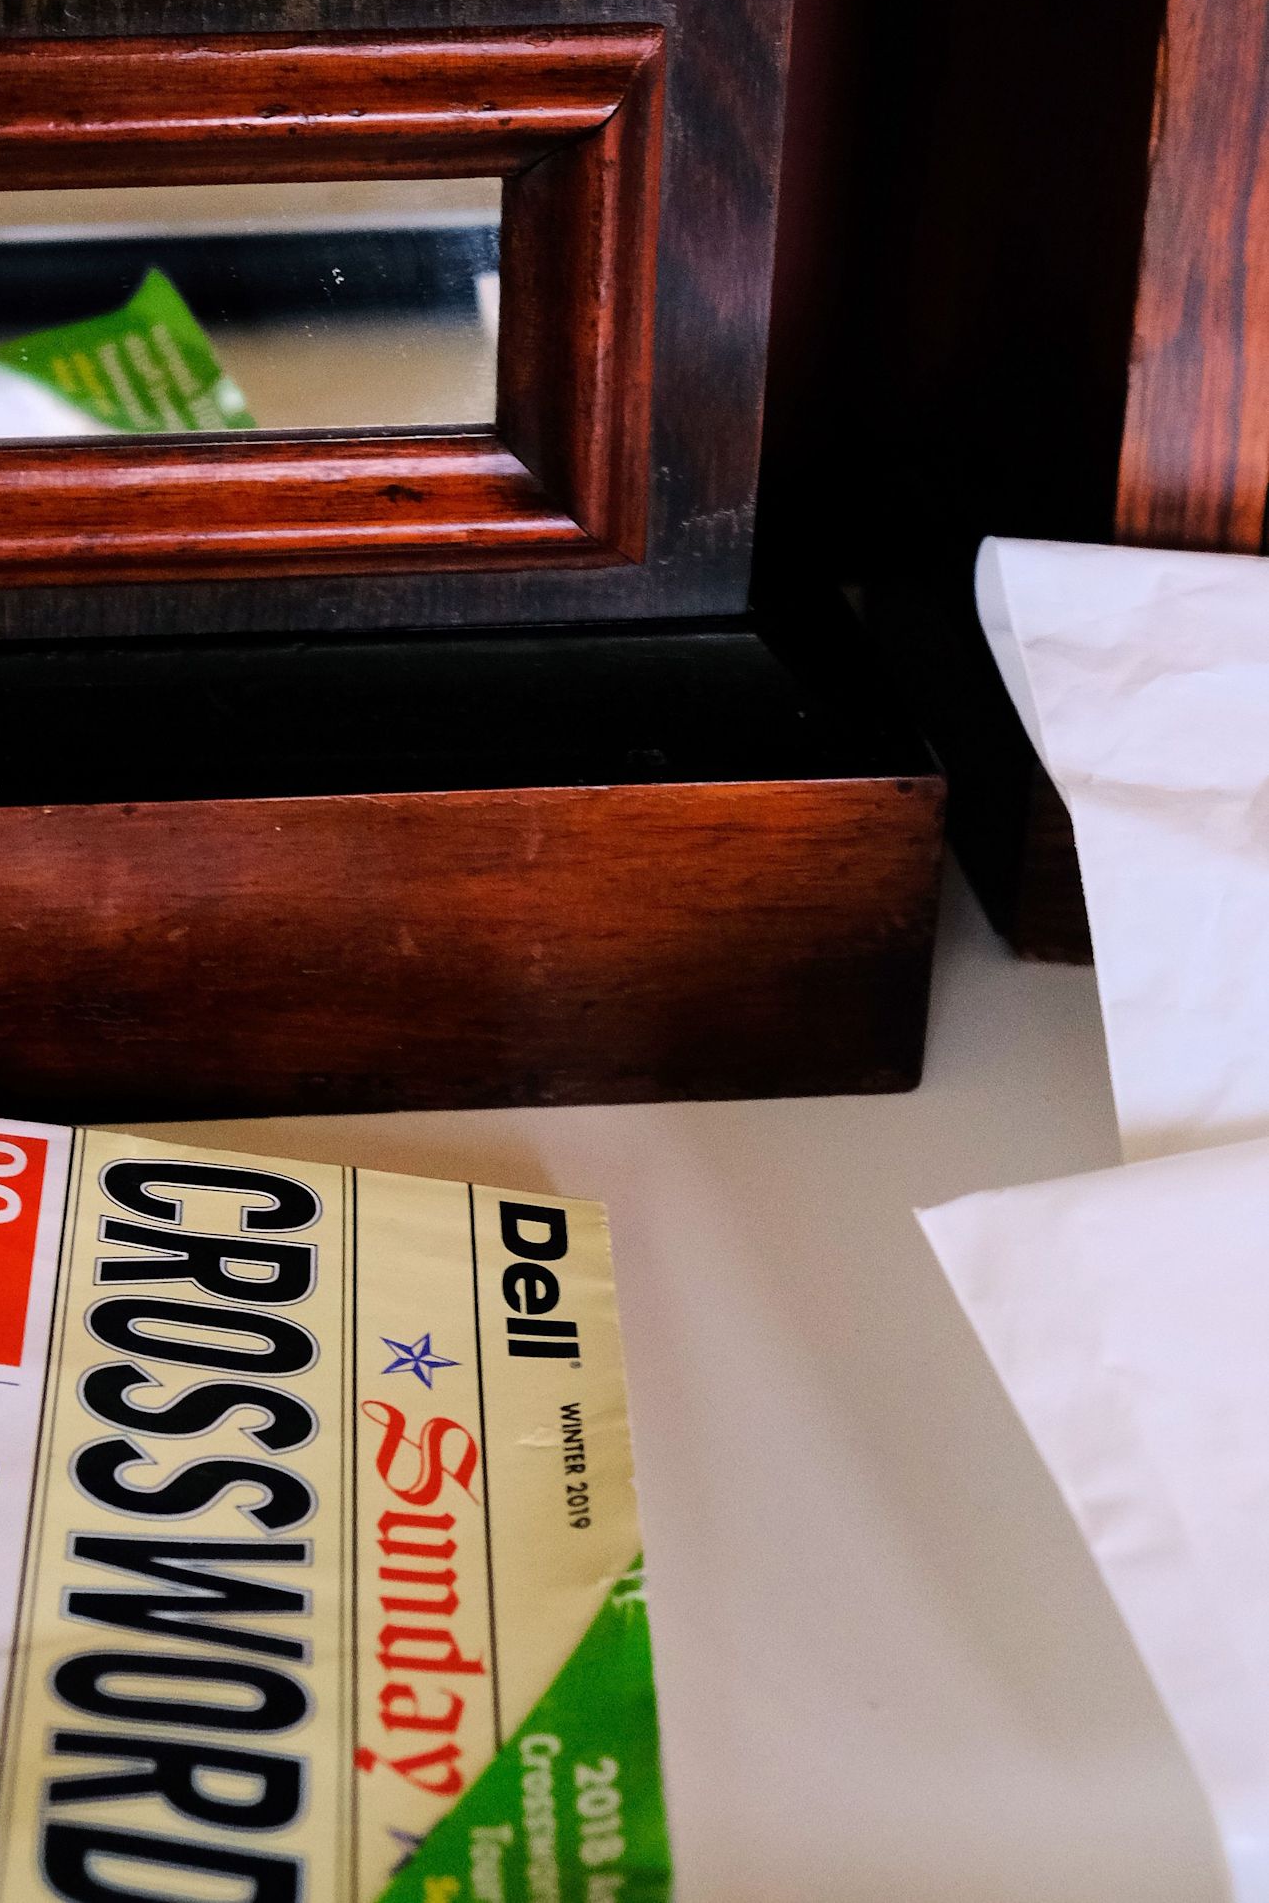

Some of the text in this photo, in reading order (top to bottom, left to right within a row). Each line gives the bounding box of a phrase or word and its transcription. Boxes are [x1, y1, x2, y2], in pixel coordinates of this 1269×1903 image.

[499, 1200, 580, 1358] Dell
[560, 1402, 591, 1530] WINTER 2019
[355, 1399, 486, 1797] Sunday
